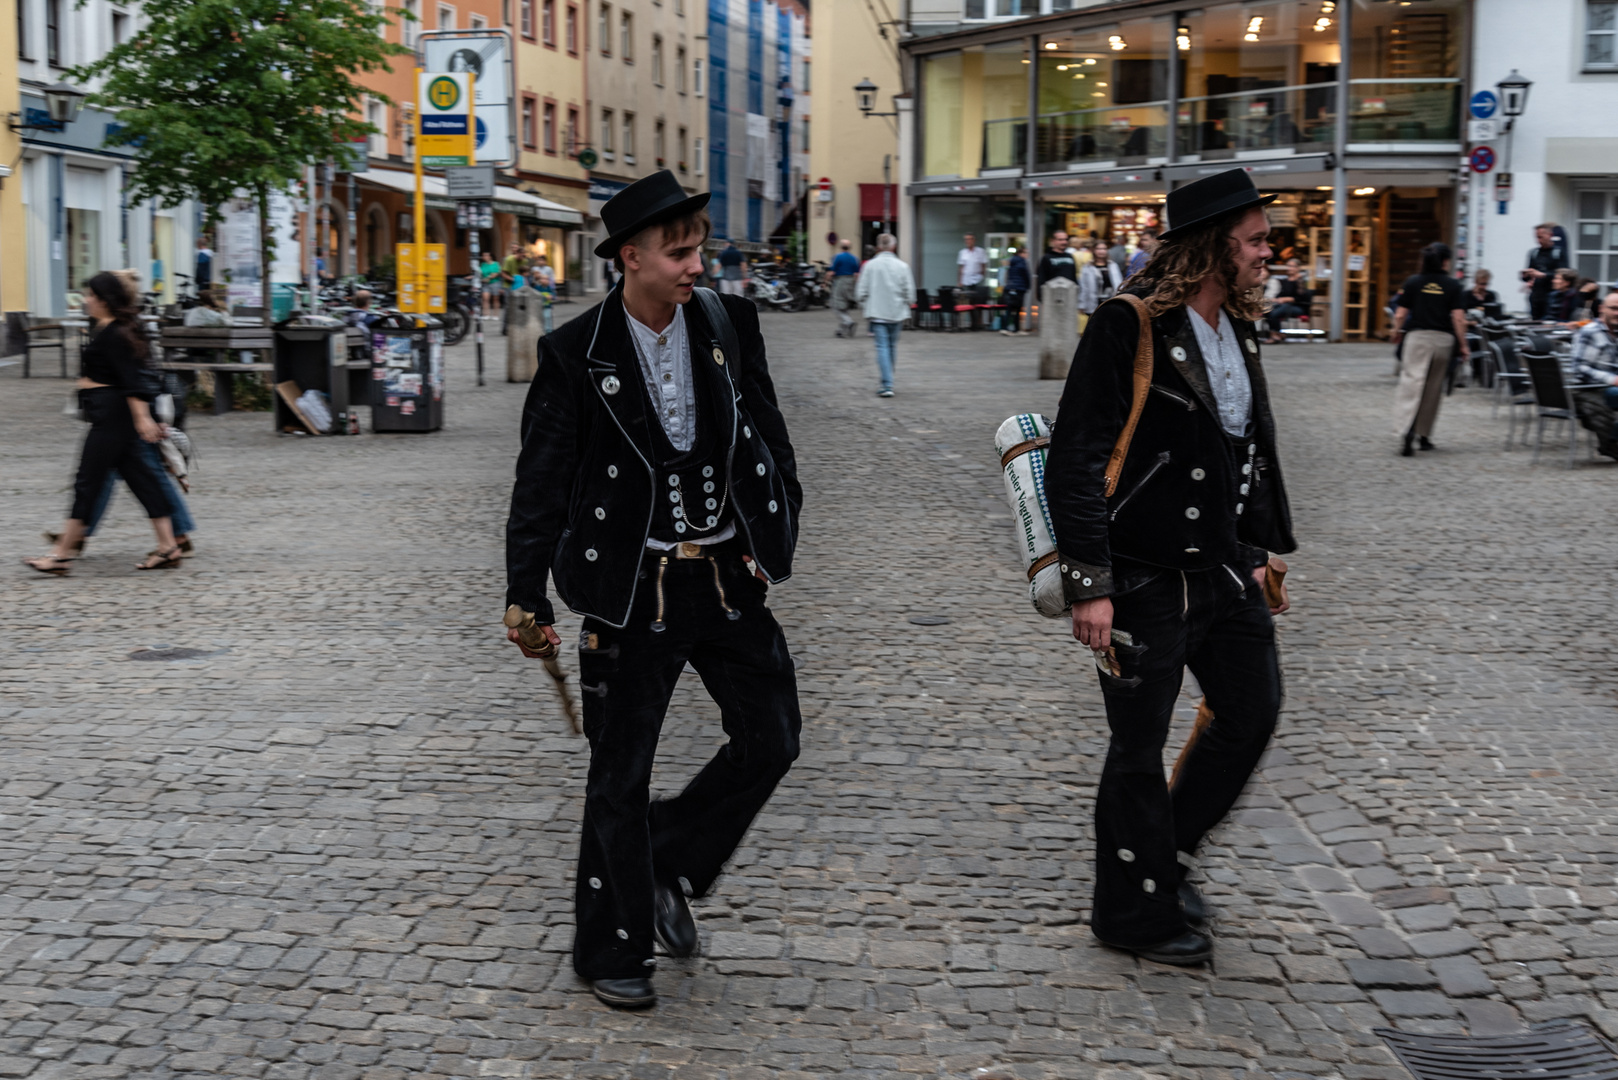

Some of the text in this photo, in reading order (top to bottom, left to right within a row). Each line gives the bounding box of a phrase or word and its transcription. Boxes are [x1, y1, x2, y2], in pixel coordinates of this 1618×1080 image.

[435, 83, 453, 104] H
[1006, 462, 1022, 493] Freier
[1017, 490, 1037, 553] Vogtländer
